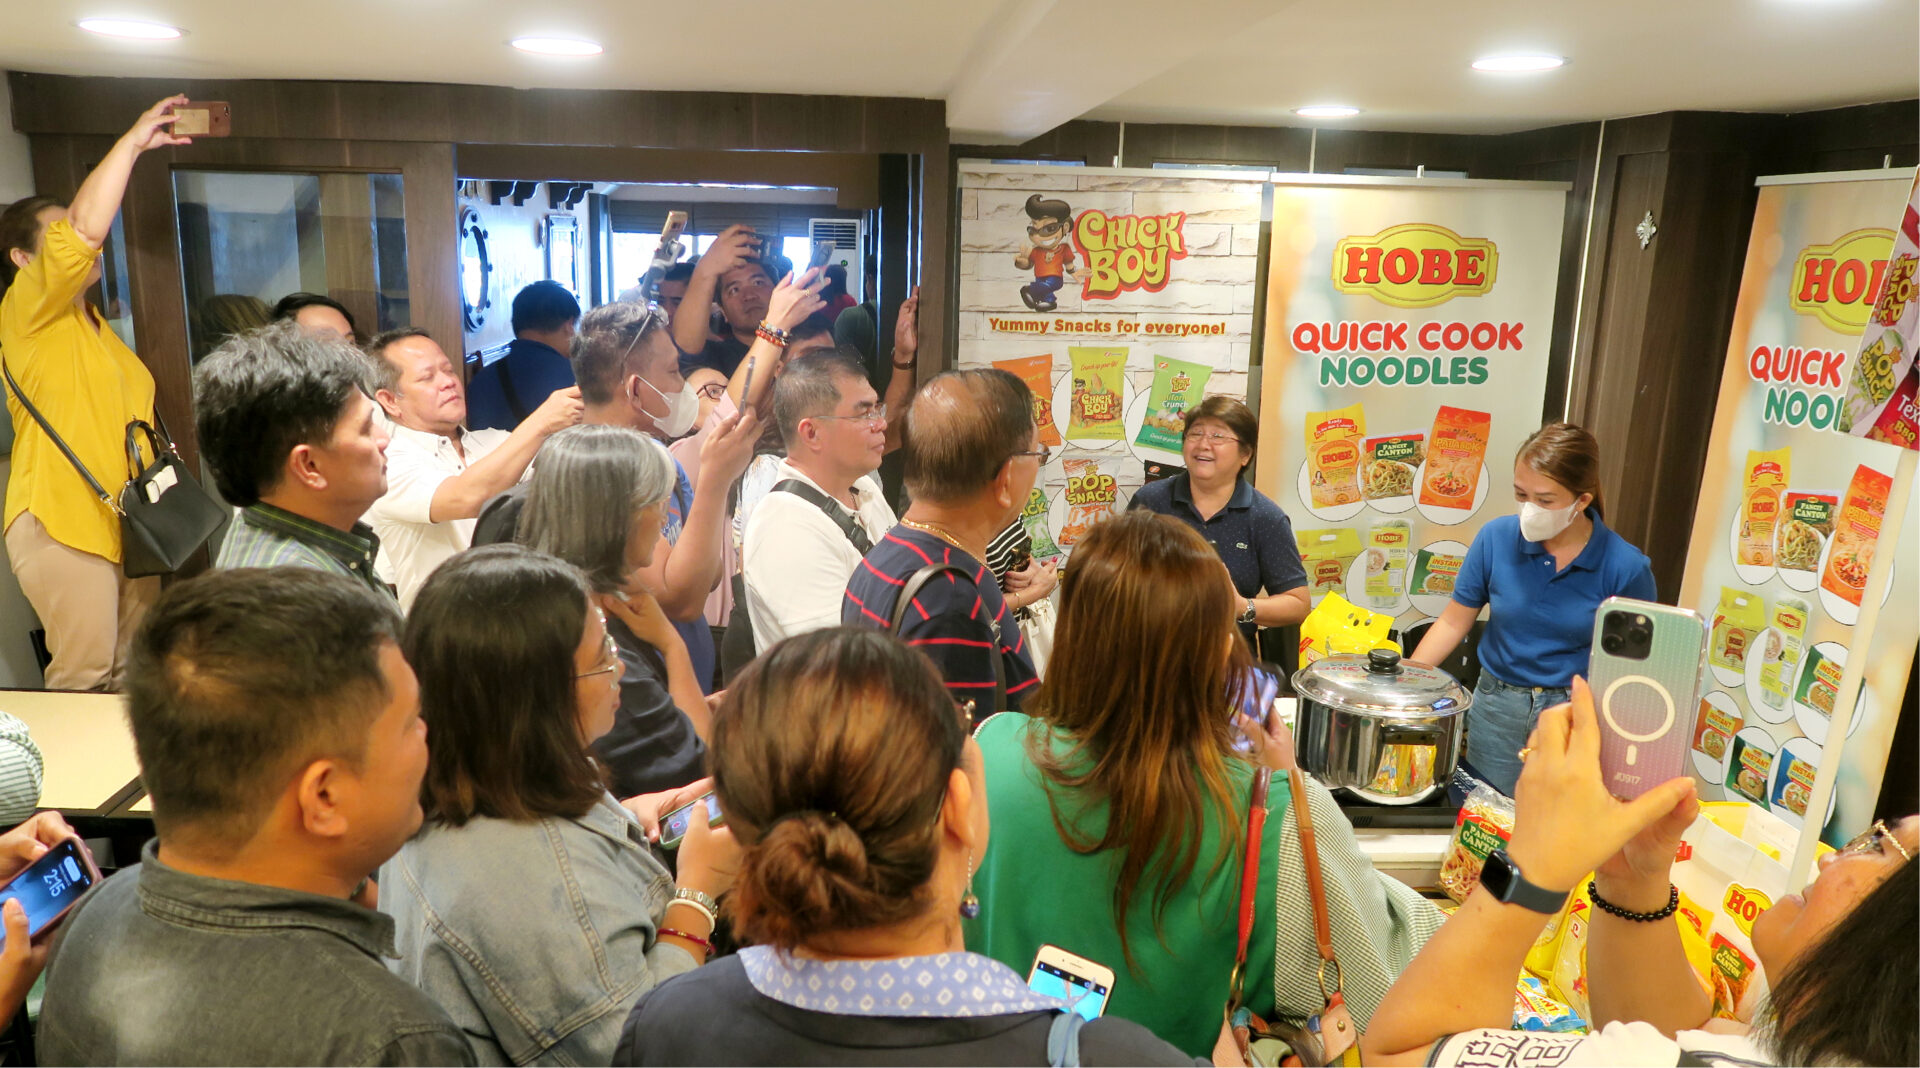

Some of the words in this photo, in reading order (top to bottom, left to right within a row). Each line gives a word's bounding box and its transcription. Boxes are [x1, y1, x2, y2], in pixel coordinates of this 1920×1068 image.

[1078, 211, 1183, 252] CHICK
[1088, 246, 1167, 292] BOY
[1343, 247, 1486, 286] HOBE
[1892, 259, 1918, 321] POP
[989, 318, 1050, 333] Yummy
[1054, 319, 1111, 333] Snacks
[1117, 319, 1140, 333] for
[1145, 321, 1226, 336] everyone!
[1292, 322, 1408, 353] QUICK
[1418, 322, 1524, 351] COOK
[1320, 356, 1489, 385] NOODLES
[1750, 346, 1845, 388] QUICK
[1870, 338, 1896, 390] POP
[1861, 351, 1884, 406] SNACK
[1081, 393, 1113, 405] CHICK
[1085, 403, 1108, 416] BOY
[1897, 394, 1919, 424] Tex
[1322, 450, 1353, 464] HOBE
[1377, 448, 1412, 456] CANTON
[1068, 474, 1113, 493] POP
[1067, 490, 1115, 505] SNACK
[1795, 509, 1828, 519] CANTON
[1819, 663, 1842, 681] INSTA
[1793, 764, 1815, 782] INSTAN
[1470, 825, 1500, 848] PANCIT
[1727, 889, 1764, 922] HO
